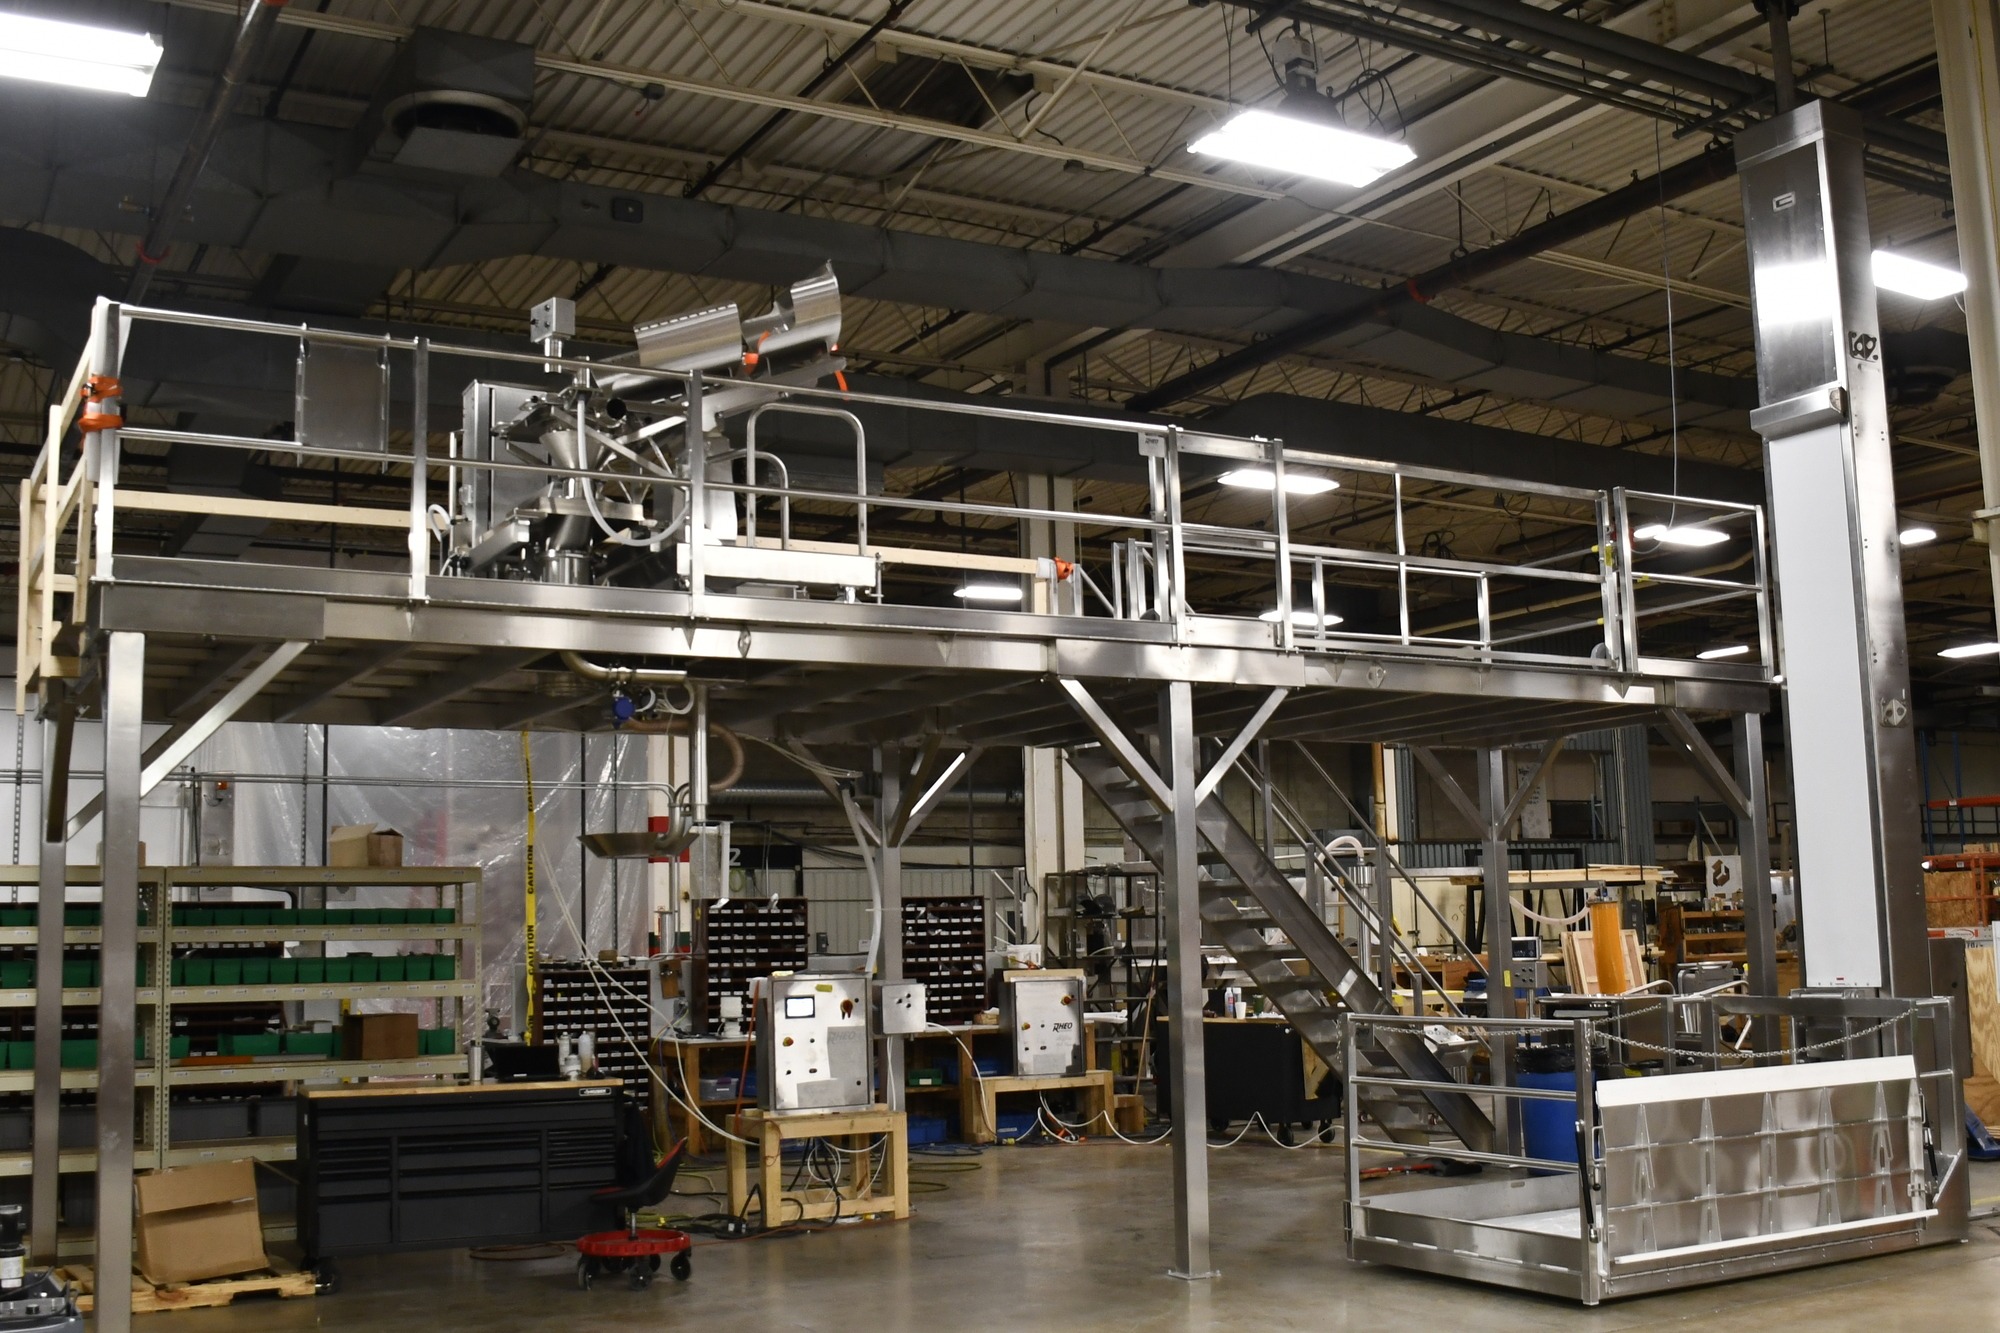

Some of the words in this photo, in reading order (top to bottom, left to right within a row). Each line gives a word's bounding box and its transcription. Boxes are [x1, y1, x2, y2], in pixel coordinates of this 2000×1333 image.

[527, 845, 535, 893] CAUTION
[527, 925, 535, 975] CAUTION
[1053, 1022, 1073, 1033] RHEO
